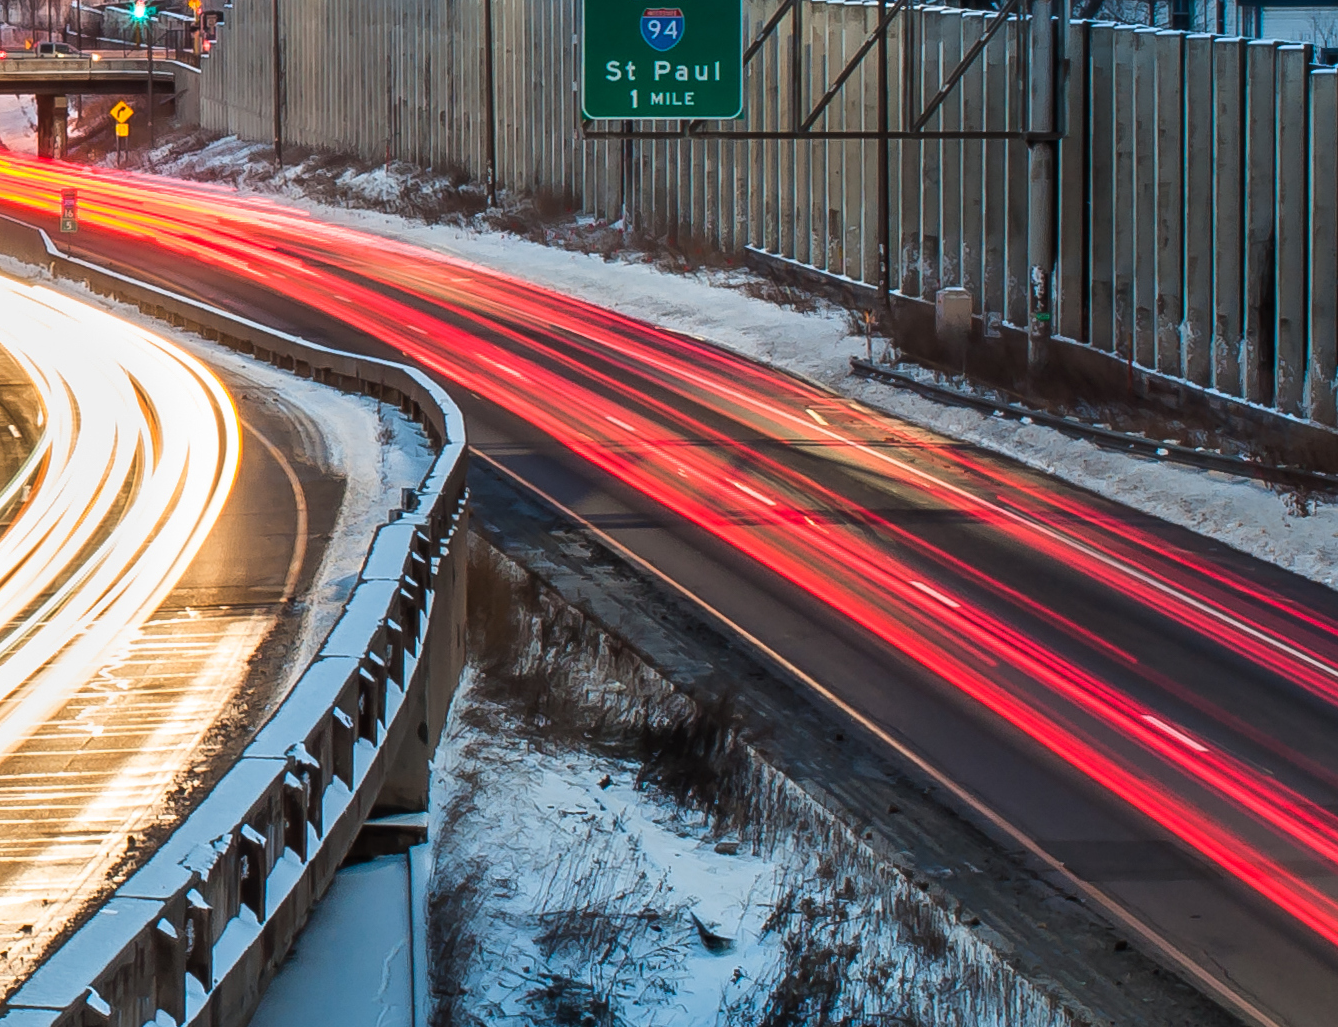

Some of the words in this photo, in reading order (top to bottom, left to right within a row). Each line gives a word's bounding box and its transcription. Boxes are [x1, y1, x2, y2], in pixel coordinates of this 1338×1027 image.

[647, 19, 678, 39] 94
[605, 60, 636, 81] St
[654, 60, 720, 81] Paul
[629, 89, 639, 108] 1
[650, 92, 694, 105] MILE
[64, 209, 74, 218] 16
